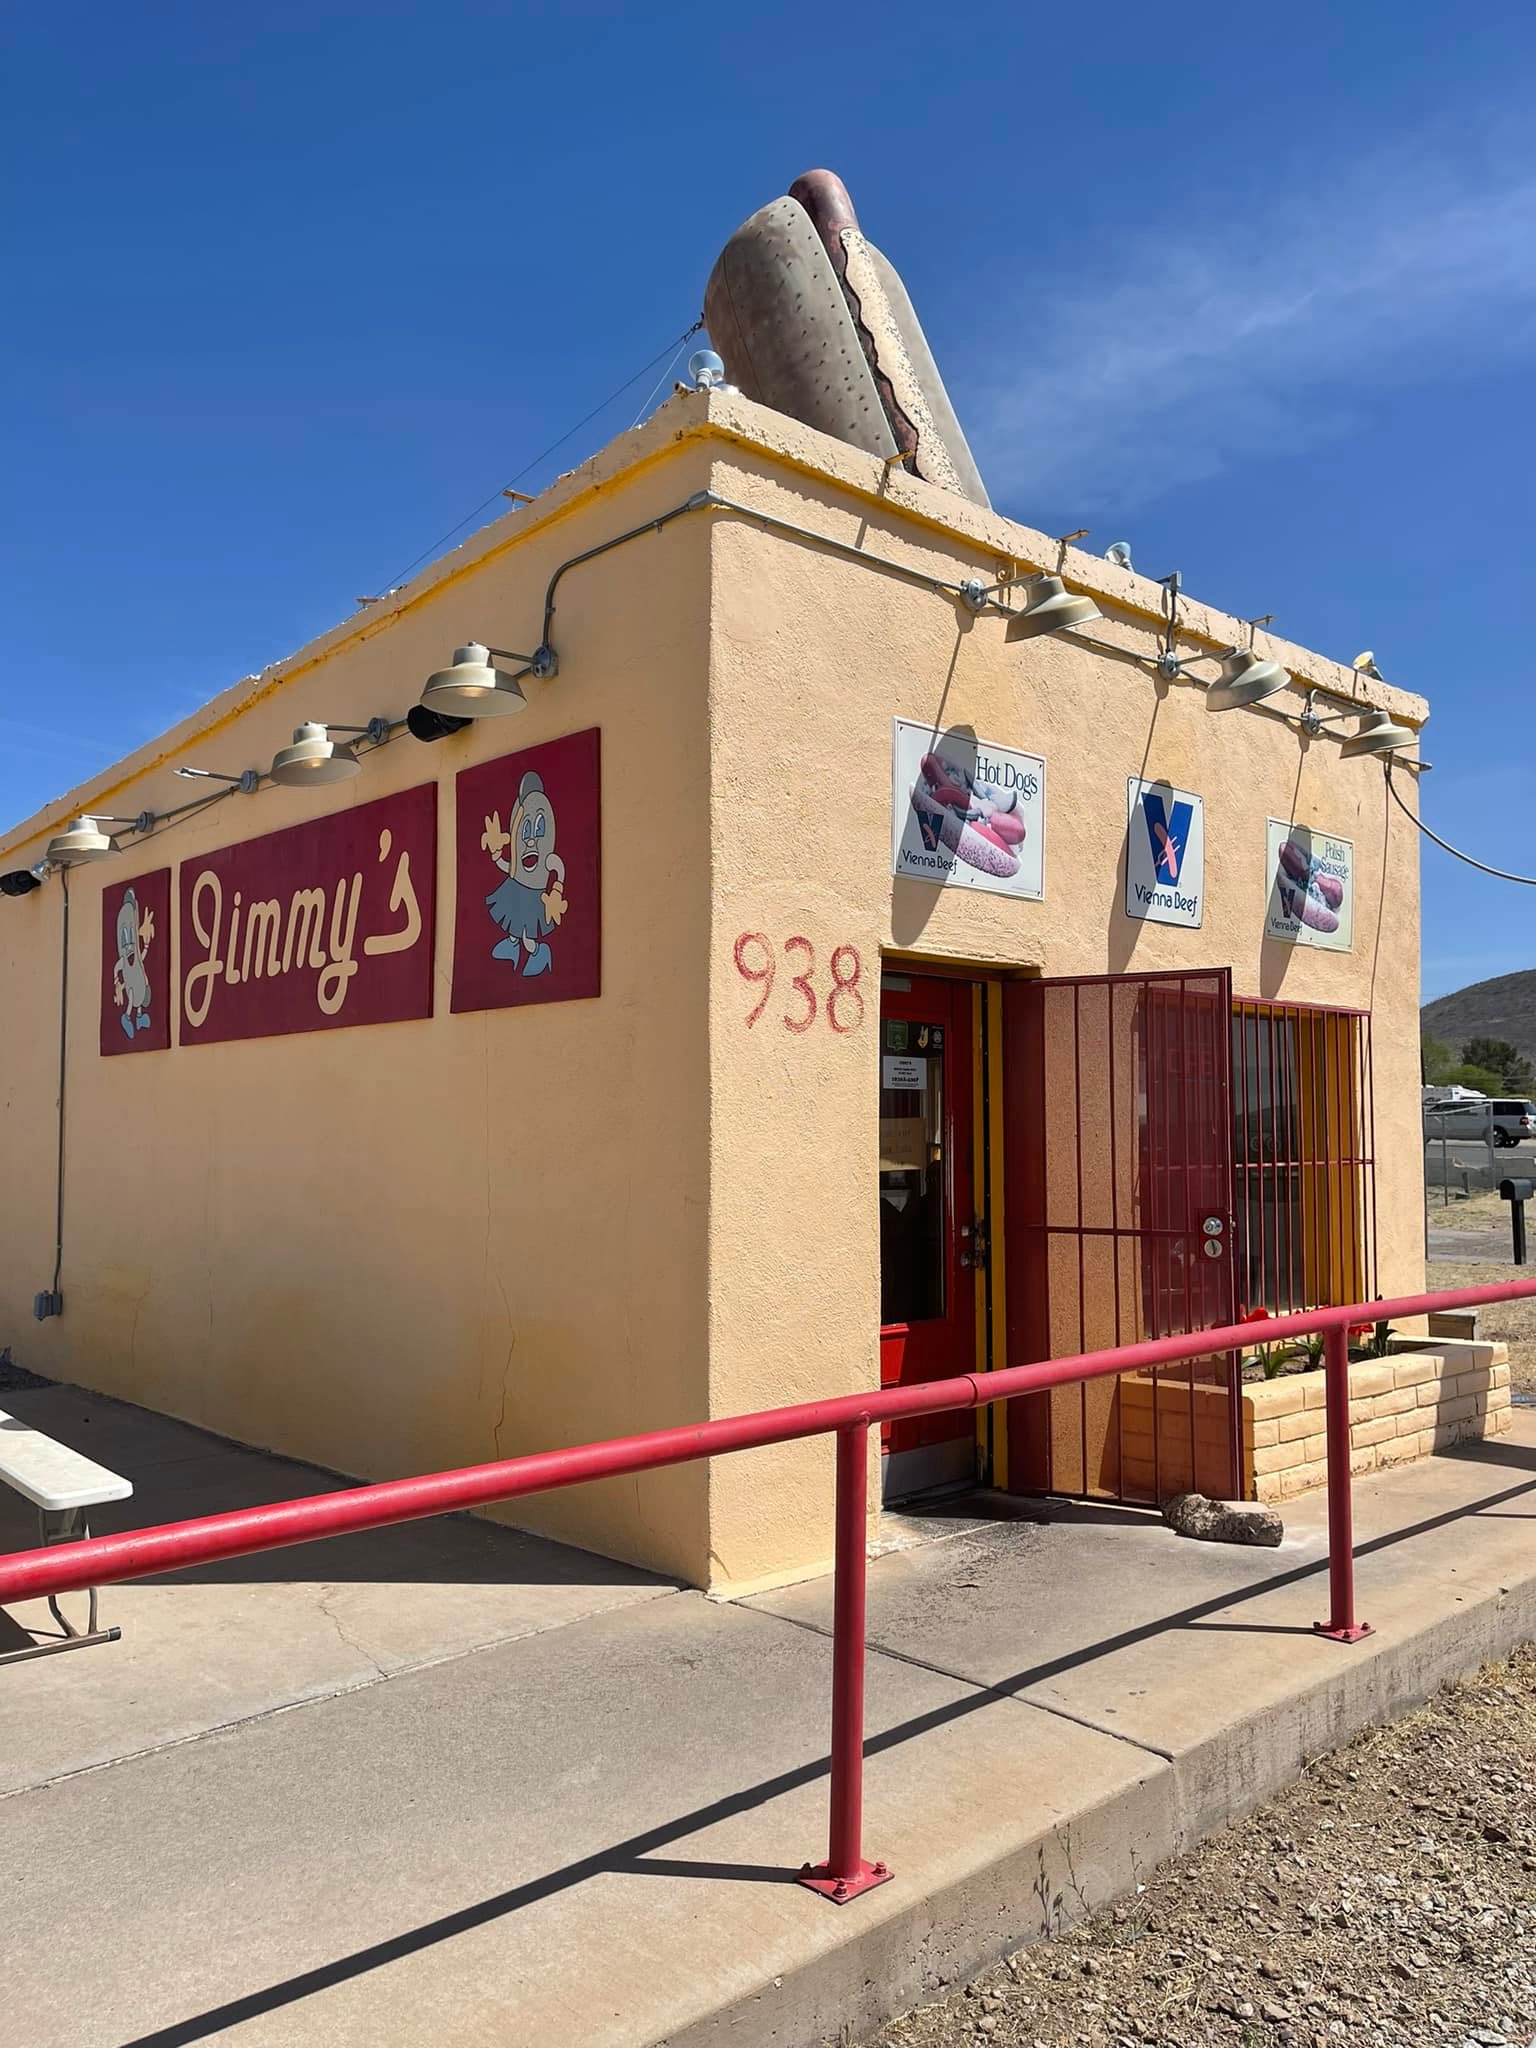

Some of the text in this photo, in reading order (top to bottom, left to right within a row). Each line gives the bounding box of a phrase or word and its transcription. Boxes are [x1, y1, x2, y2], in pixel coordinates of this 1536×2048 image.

[976, 755, 1038, 801] Hot Dogs
[902, 849, 958, 875] Vienna Beef
[1325, 841, 1345, 862] Polish
[1321, 856, 1349, 883] Sausage
[1134, 883, 1198, 918] Vienna Beef
[184, 827, 422, 1028] Jimmy's
[1271, 917, 1303, 935] Vienna Beef
[733, 932, 864, 1034] 938
